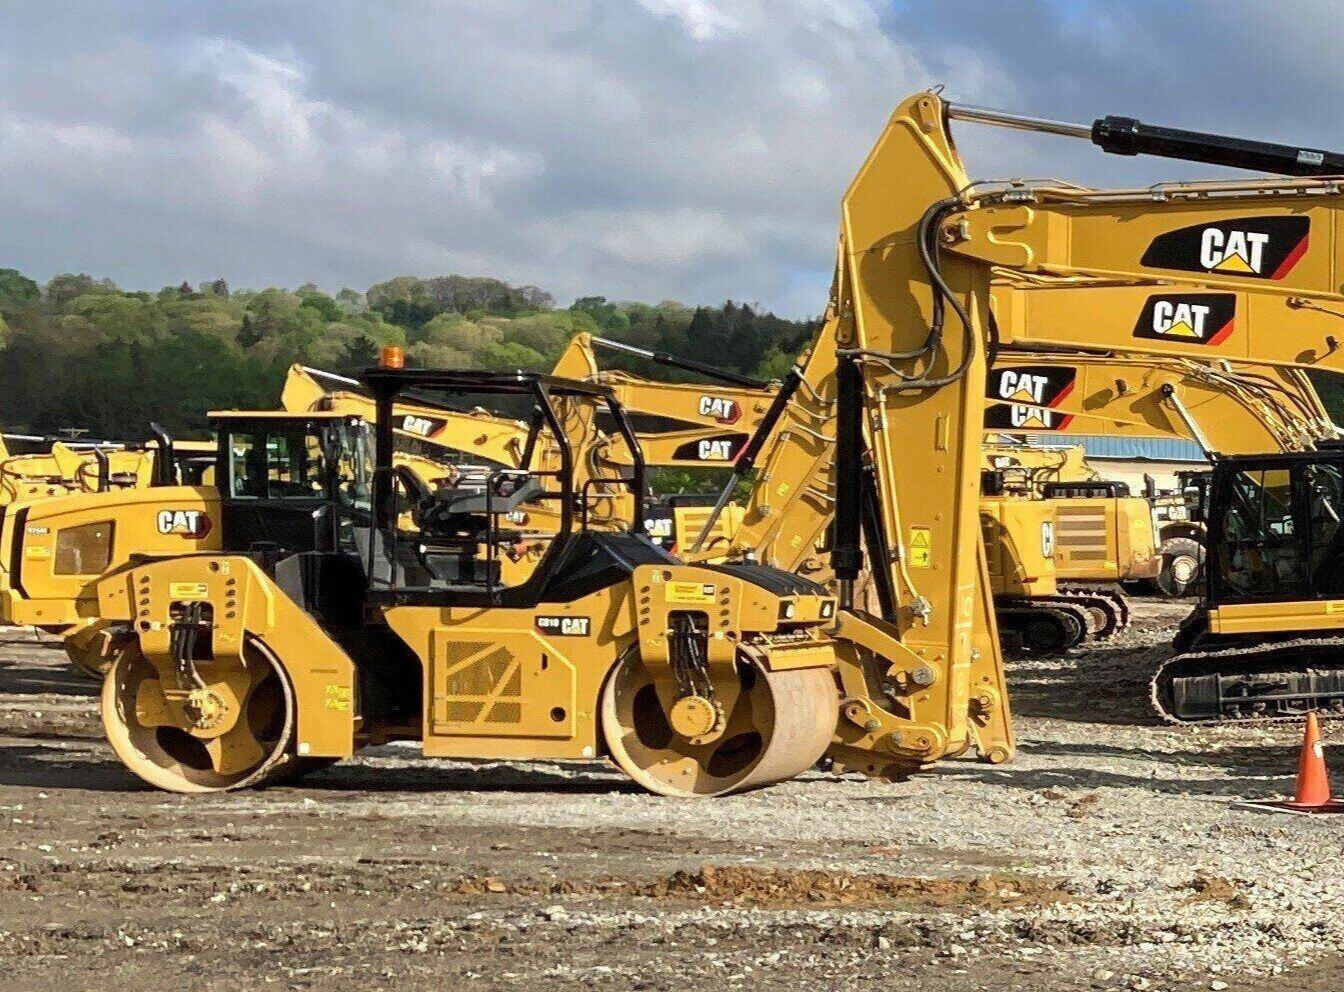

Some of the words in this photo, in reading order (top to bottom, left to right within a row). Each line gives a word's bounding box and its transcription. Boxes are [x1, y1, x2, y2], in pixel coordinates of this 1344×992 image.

[1201, 228, 1269, 273] CAT
[1153, 300, 1210, 337] CAT
[999, 370, 1048, 403] CAT
[700, 396, 733, 419] CAT
[1011, 404, 1051, 428] CAT
[402, 415, 433, 437] CAT
[698, 440, 732, 460] CAT
[157, 510, 200, 535] CAT
[643, 518, 673, 537] CAT
[561, 618, 589, 635] CAT
